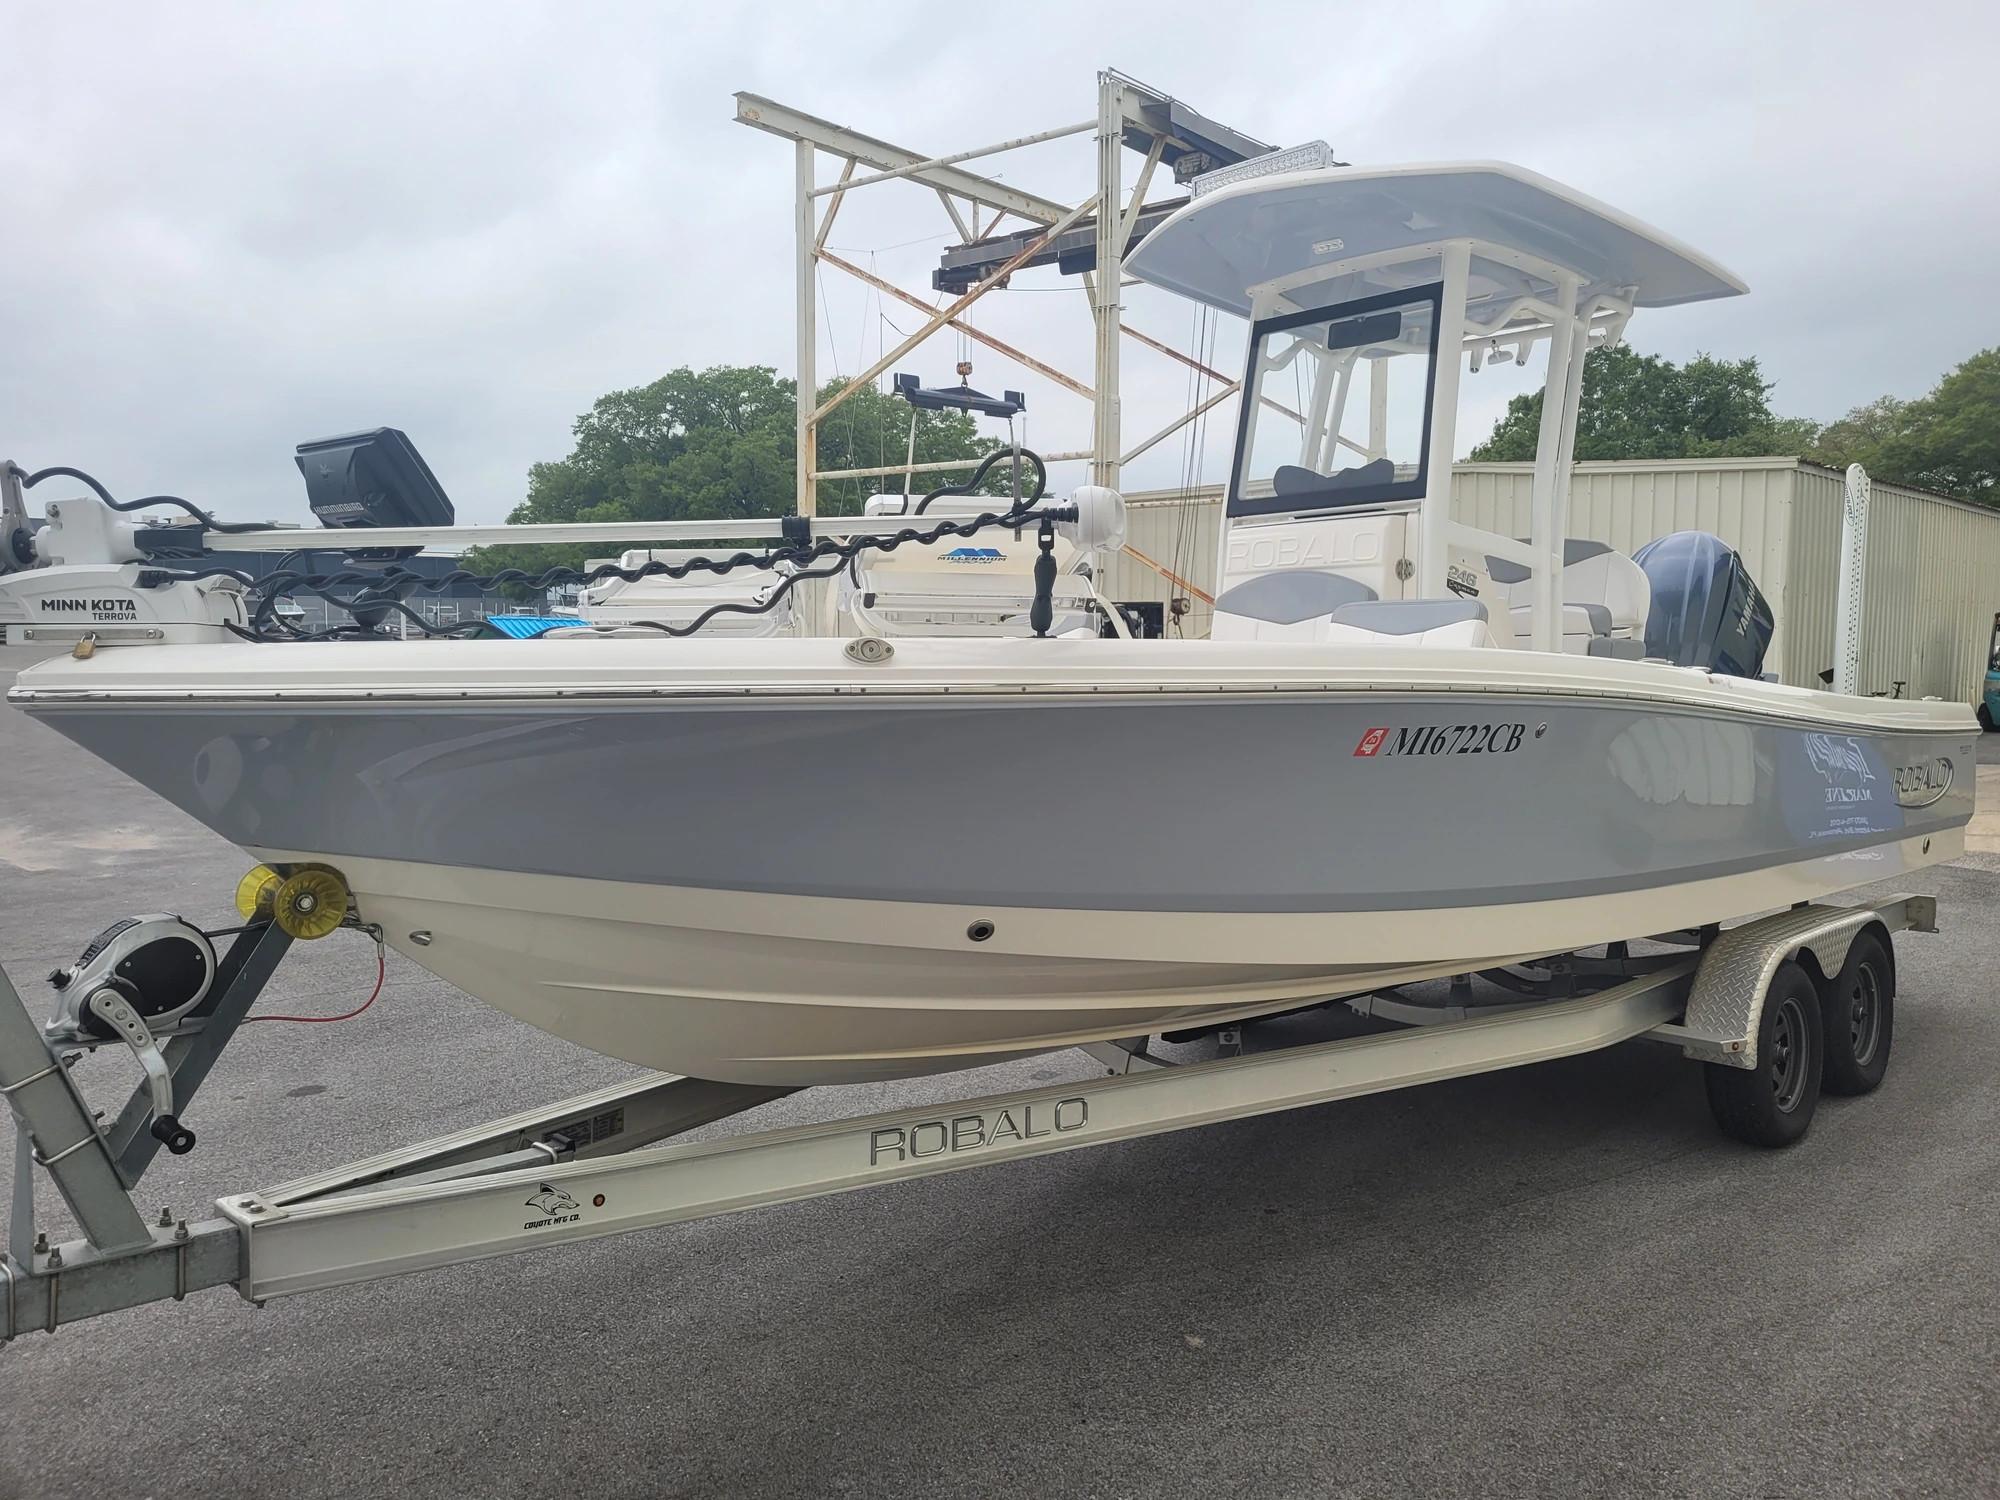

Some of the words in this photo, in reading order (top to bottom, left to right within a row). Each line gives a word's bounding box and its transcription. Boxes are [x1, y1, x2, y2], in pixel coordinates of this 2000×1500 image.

[1227, 531, 1380, 572] ROBALO
[1447, 564, 1478, 587] 246
[41, 599, 87, 611] MINN
[91, 599, 136, 611] KOTA
[92, 612, 137, 621] TERROVA
[1384, 723, 1527, 757] MI6722CB
[1891, 762, 1948, 795] ROBALO
[870, 1098, 1089, 1166] ROBALO
[524, 1218, 553, 1230] COYOTE
[553, 1215, 569, 1225] MFG
[569, 1213, 581, 1222] CO.
